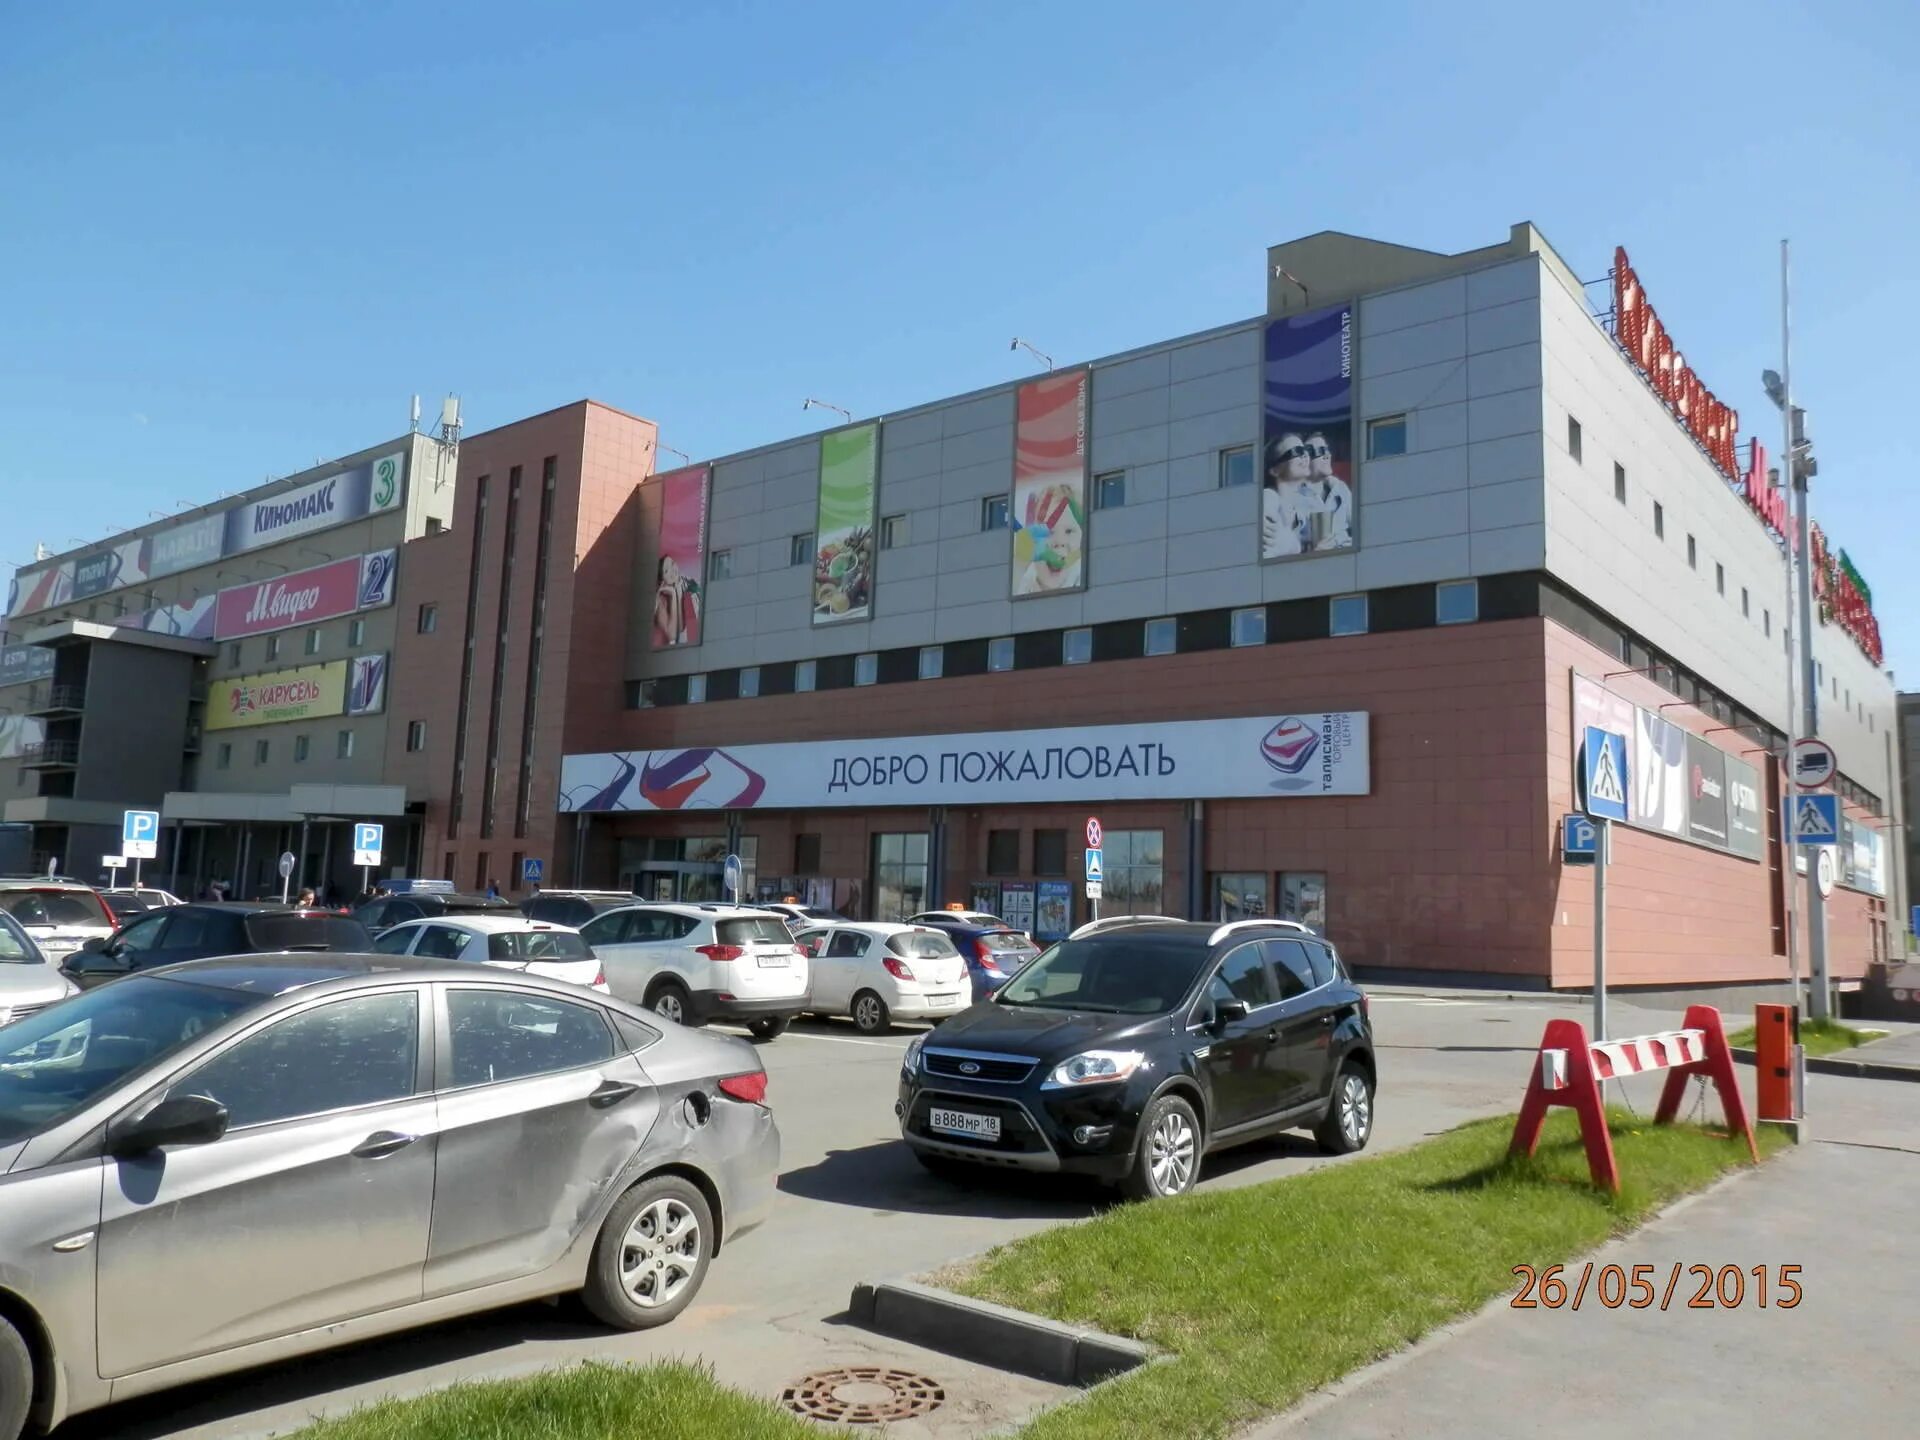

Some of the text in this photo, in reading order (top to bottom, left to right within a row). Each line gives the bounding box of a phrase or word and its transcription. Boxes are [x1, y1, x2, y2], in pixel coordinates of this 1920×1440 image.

[1341, 312, 1351, 378] КИНОТЕАТР
[374, 459, 396, 507] 3
[254, 480, 337, 534] КИНОМАКС
[363, 552, 389, 603] 2
[246, 583, 320, 624] М.видео
[258, 681, 321, 706] КАРУСЕЛЬ
[1323, 714, 1332, 791] талисман
[1333, 713, 1341, 764] ТОРГОВЫЙ
[1342, 714, 1352, 747] ЦЕНТР
[828, 743, 1176, 793] ДОБРО ПОЖАЛОВАТЬ
[132, 815, 153, 839] P
[361, 827, 377, 849] P
[1577, 826, 1595, 848] P
[984, 1118, 996, 1129] 18
